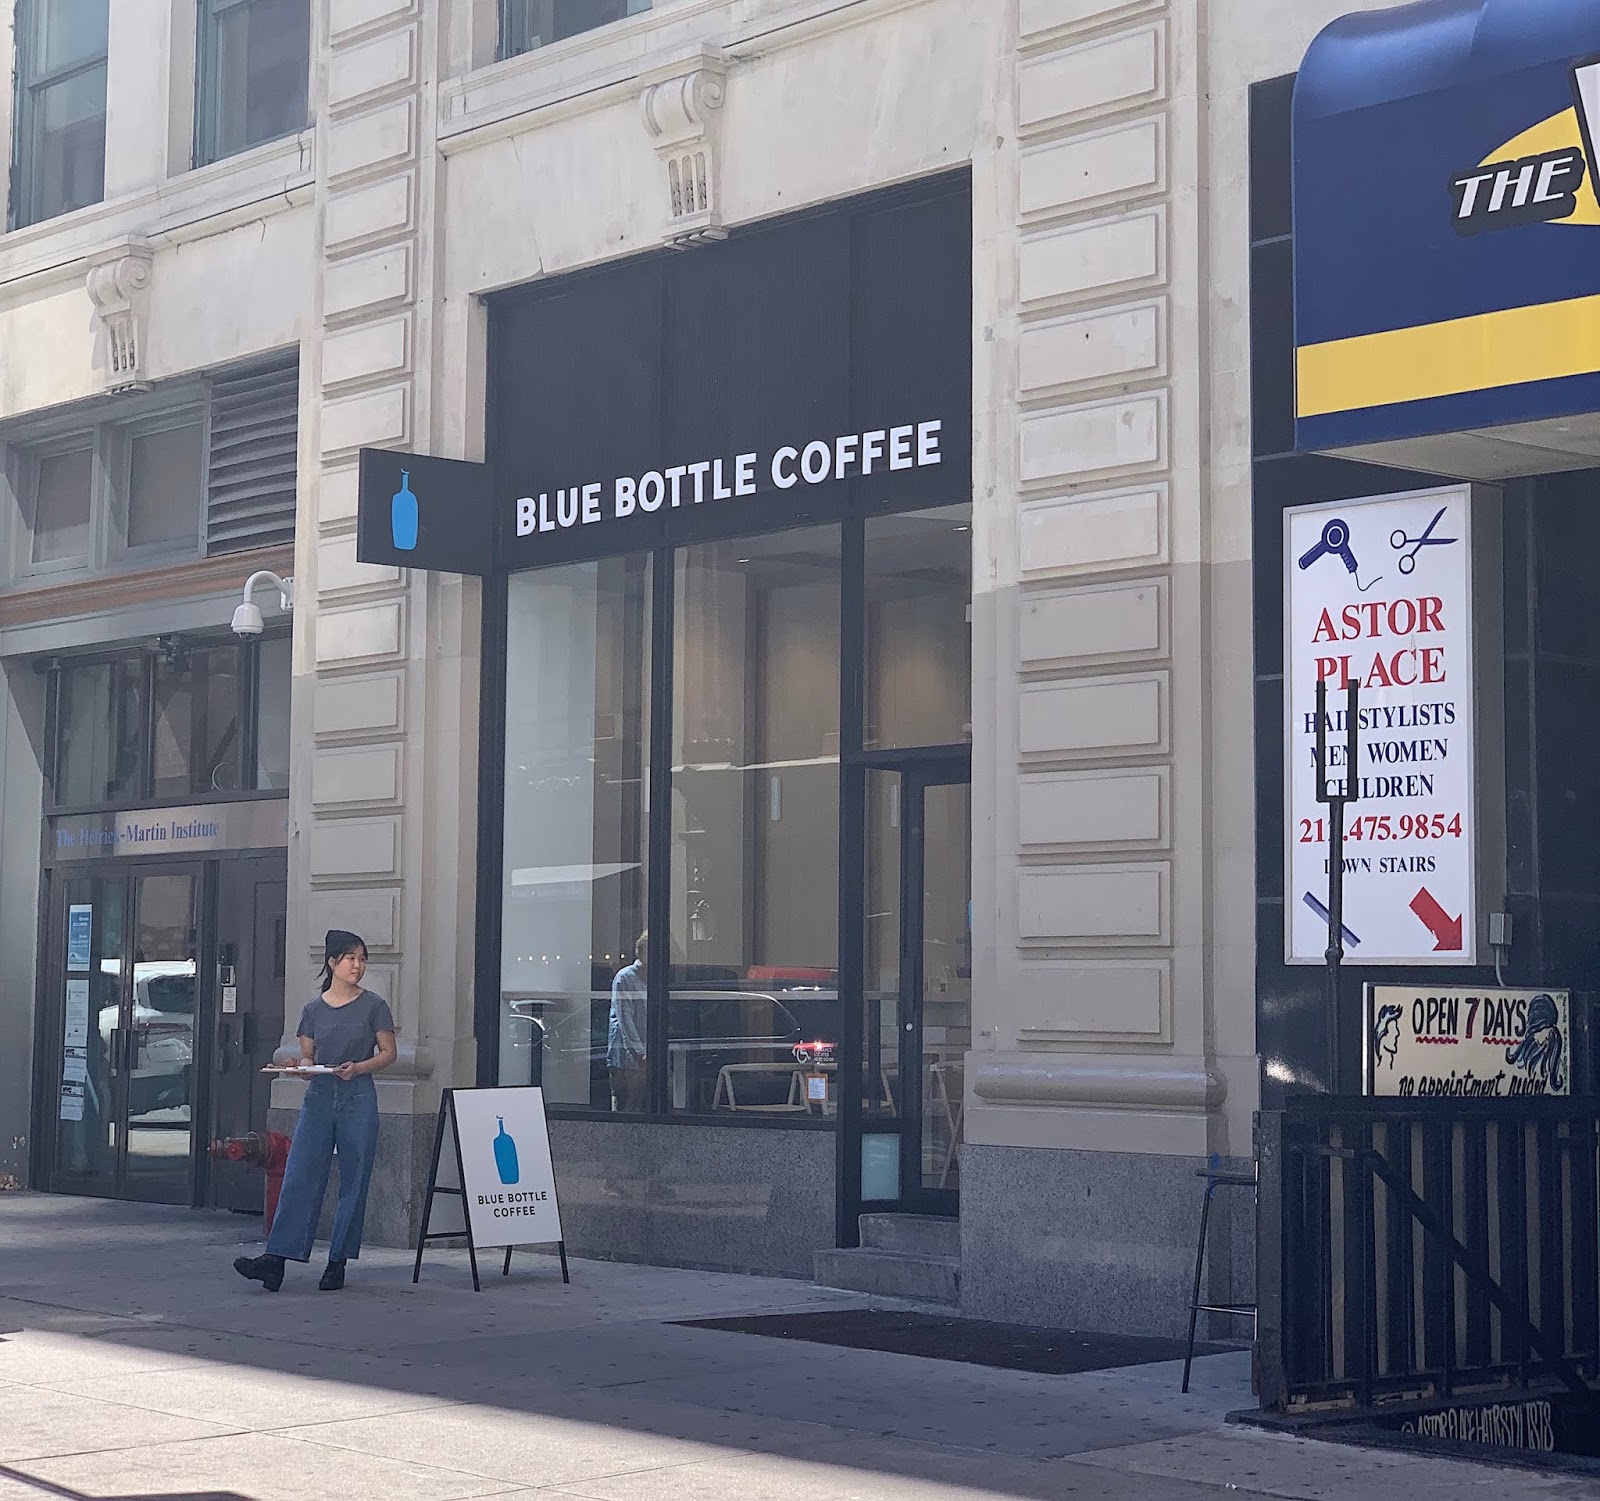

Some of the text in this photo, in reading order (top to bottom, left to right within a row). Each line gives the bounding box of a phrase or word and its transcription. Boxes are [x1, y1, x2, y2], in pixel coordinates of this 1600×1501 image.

[1455, 156, 1574, 219] THE
[516, 419, 942, 537] BLUE BOTTLE COFFEE
[1311, 596, 1446, 643] ASTOR
[1314, 647, 1446, 693] PLACE
[1367, 738, 1449, 764] WOMEN
[1325, 774, 1435, 799] CHLDREN
[171, 820, 220, 840] Institute
[1299, 812, 1462, 843] 21.475.9854
[1379, 856, 1436, 874] STAIRS
[1412, 997, 1527, 1039] OPEN 7 DAYS
[1399, 1075, 1415, 1096] no
[1417, 1069, 1506, 1096] appointment
[478, 1191, 548, 1205] BLUE BOTTLE
[493, 1206, 536, 1218] COFFEE
